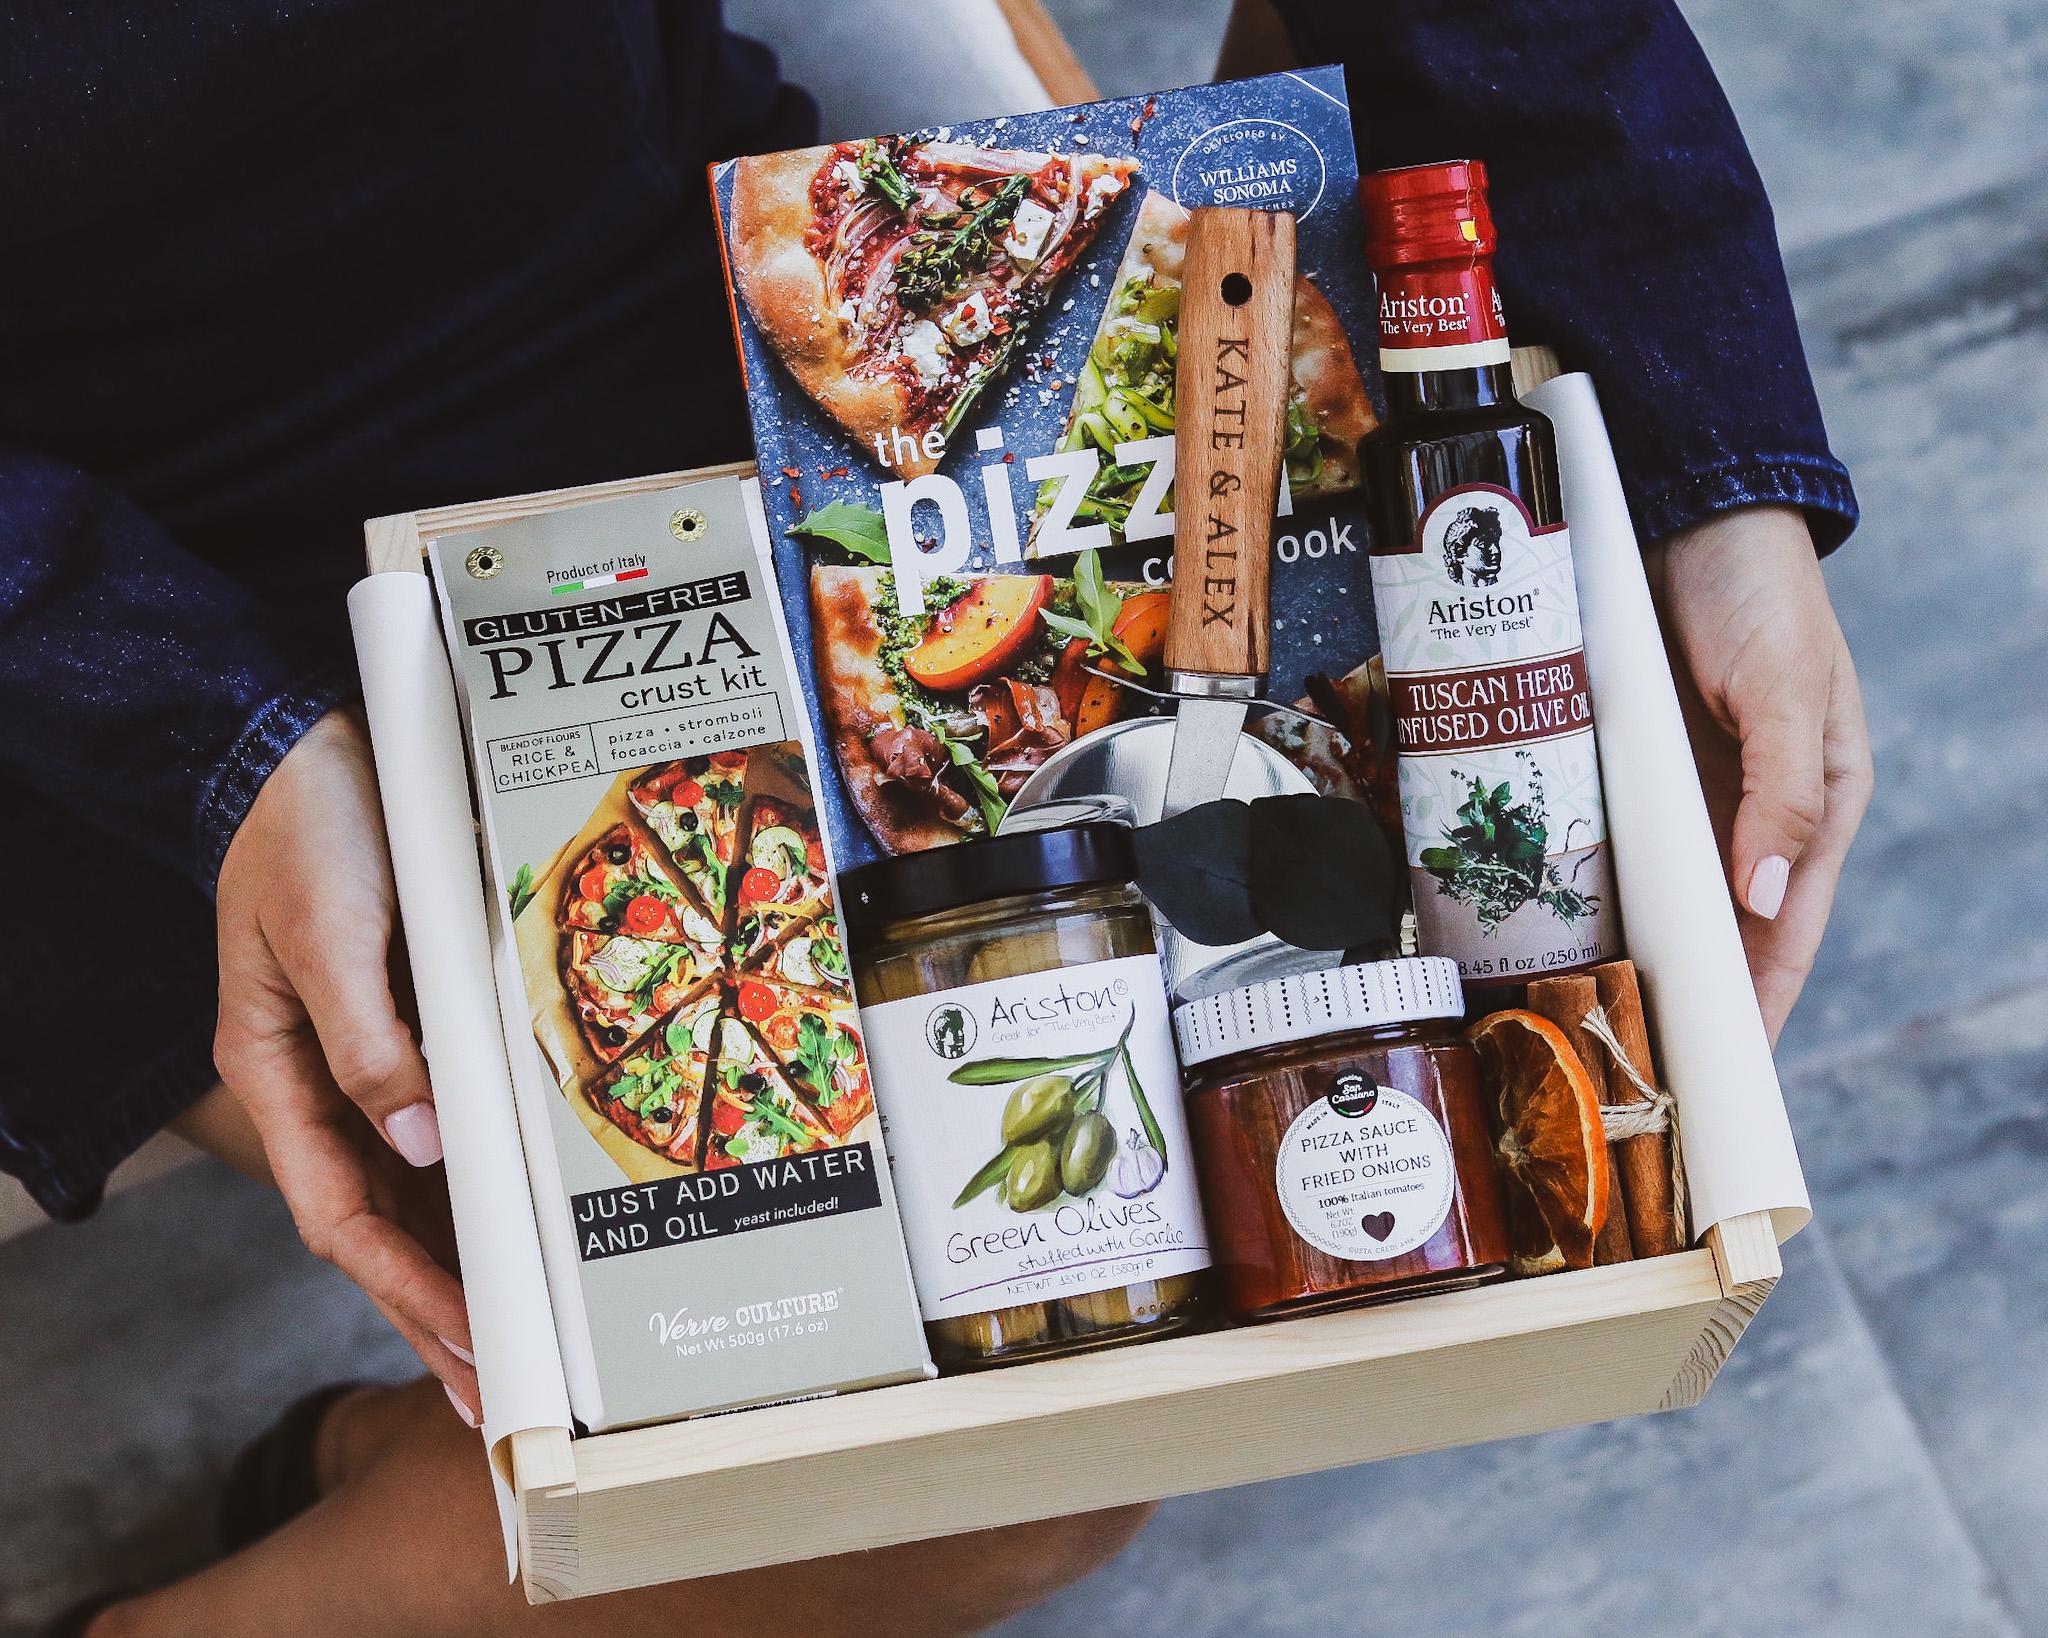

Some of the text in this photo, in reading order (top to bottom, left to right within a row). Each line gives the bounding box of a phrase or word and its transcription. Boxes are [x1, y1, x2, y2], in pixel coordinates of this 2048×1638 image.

[1203, 129, 1286, 155] DEVELOPED BY
[1200, 159, 1297, 187] WILLIAMS
[1214, 178, 1292, 204] SONOMA
[1403, 320, 1433, 337] Very
[873, 426, 946, 468] the
[1202, 337, 1249, 629] KATE & ALEX
[879, 426, 1293, 617] pizz
[547, 553, 646, 583] Product of Italy
[475, 576, 742, 640] GLUTEN-FREE
[1465, 623, 1497, 637] Very
[479, 611, 761, 700] PIZZA
[620, 664, 767, 709] crust kit
[1408, 663, 1574, 712] TUSCAN HERB
[608, 707, 763, 746] pizza stromboli
[1497, 697, 1565, 735] OLIVE
[500, 731, 581, 753] BLEND OF FLOURS
[512, 745, 576, 766] RICE &
[610, 724, 767, 761] focaccia calzone
[499, 758, 596, 787] CHICKPEA
[1459, 959, 1494, 976] 8.45
[1500, 957, 1509, 972] fl
[1515, 957, 1536, 970] oz
[1541, 947, 1578, 968] (250
[1342, 1084, 1363, 1095] San
[1300, 1119, 1418, 1153] PIZZA SAUCE
[1306, 1115, 1321, 1130] MADE
[1321, 1110, 1328, 1118] IN
[1339, 1143, 1389, 1164] WITH
[579, 1186, 658, 1223] JUST
[676, 1173, 740, 1206] ADD
[752, 1150, 867, 1191] WATER
[1302, 1155, 1431, 1191] FRIED ONIONS
[1318, 1183, 1425, 1208] 100% Italian tomatoes
[586, 1197, 839, 1256] AND OIL yeast included!
[947, 1197, 1162, 1264] Green Olives
[1018, 1223, 1185, 1273] stuffed with Garlic
[648, 1307, 730, 1346] Verve
[675, 1316, 829, 1359] Net Wt 500g (17.6 oz)
